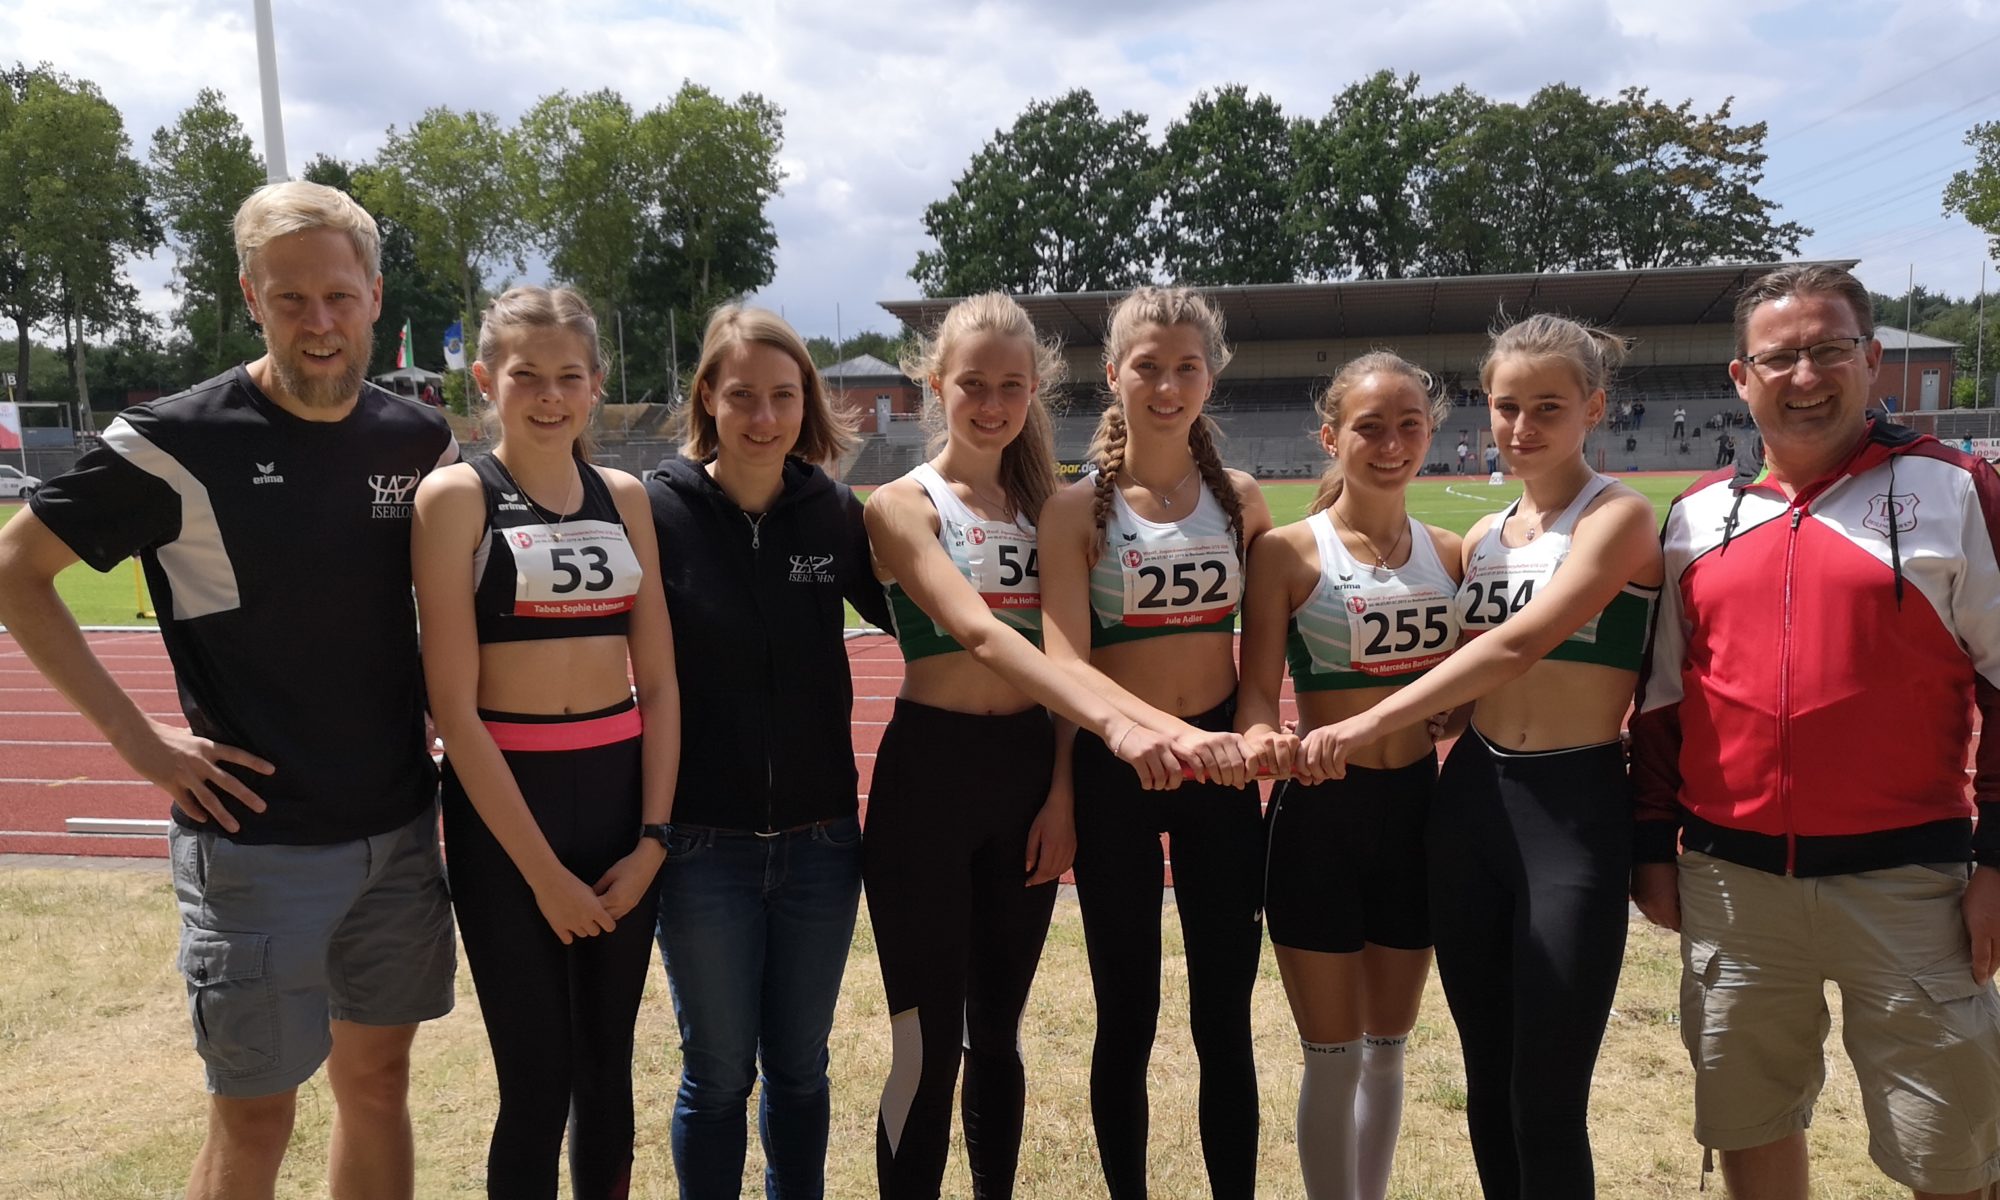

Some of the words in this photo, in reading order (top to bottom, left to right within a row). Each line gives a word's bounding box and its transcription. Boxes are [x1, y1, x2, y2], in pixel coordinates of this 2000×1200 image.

[253, 474, 284, 484] erima
[372, 505, 413, 518] ISERLO
[498, 503, 528, 511] erima
[550, 546, 614, 593] 53
[998, 545, 1039, 586] 54
[1137, 560, 1228, 608] 252
[1002, 596, 1018, 604] Julia
[1465, 580, 1535, 623] 254
[534, 604, 561, 613] Tabea
[562, 602, 592, 614] Sophie
[1182, 615, 1203, 623] Adler
[1362, 605, 1448, 656] 255
[1380, 662, 1412, 672] Mercedes
